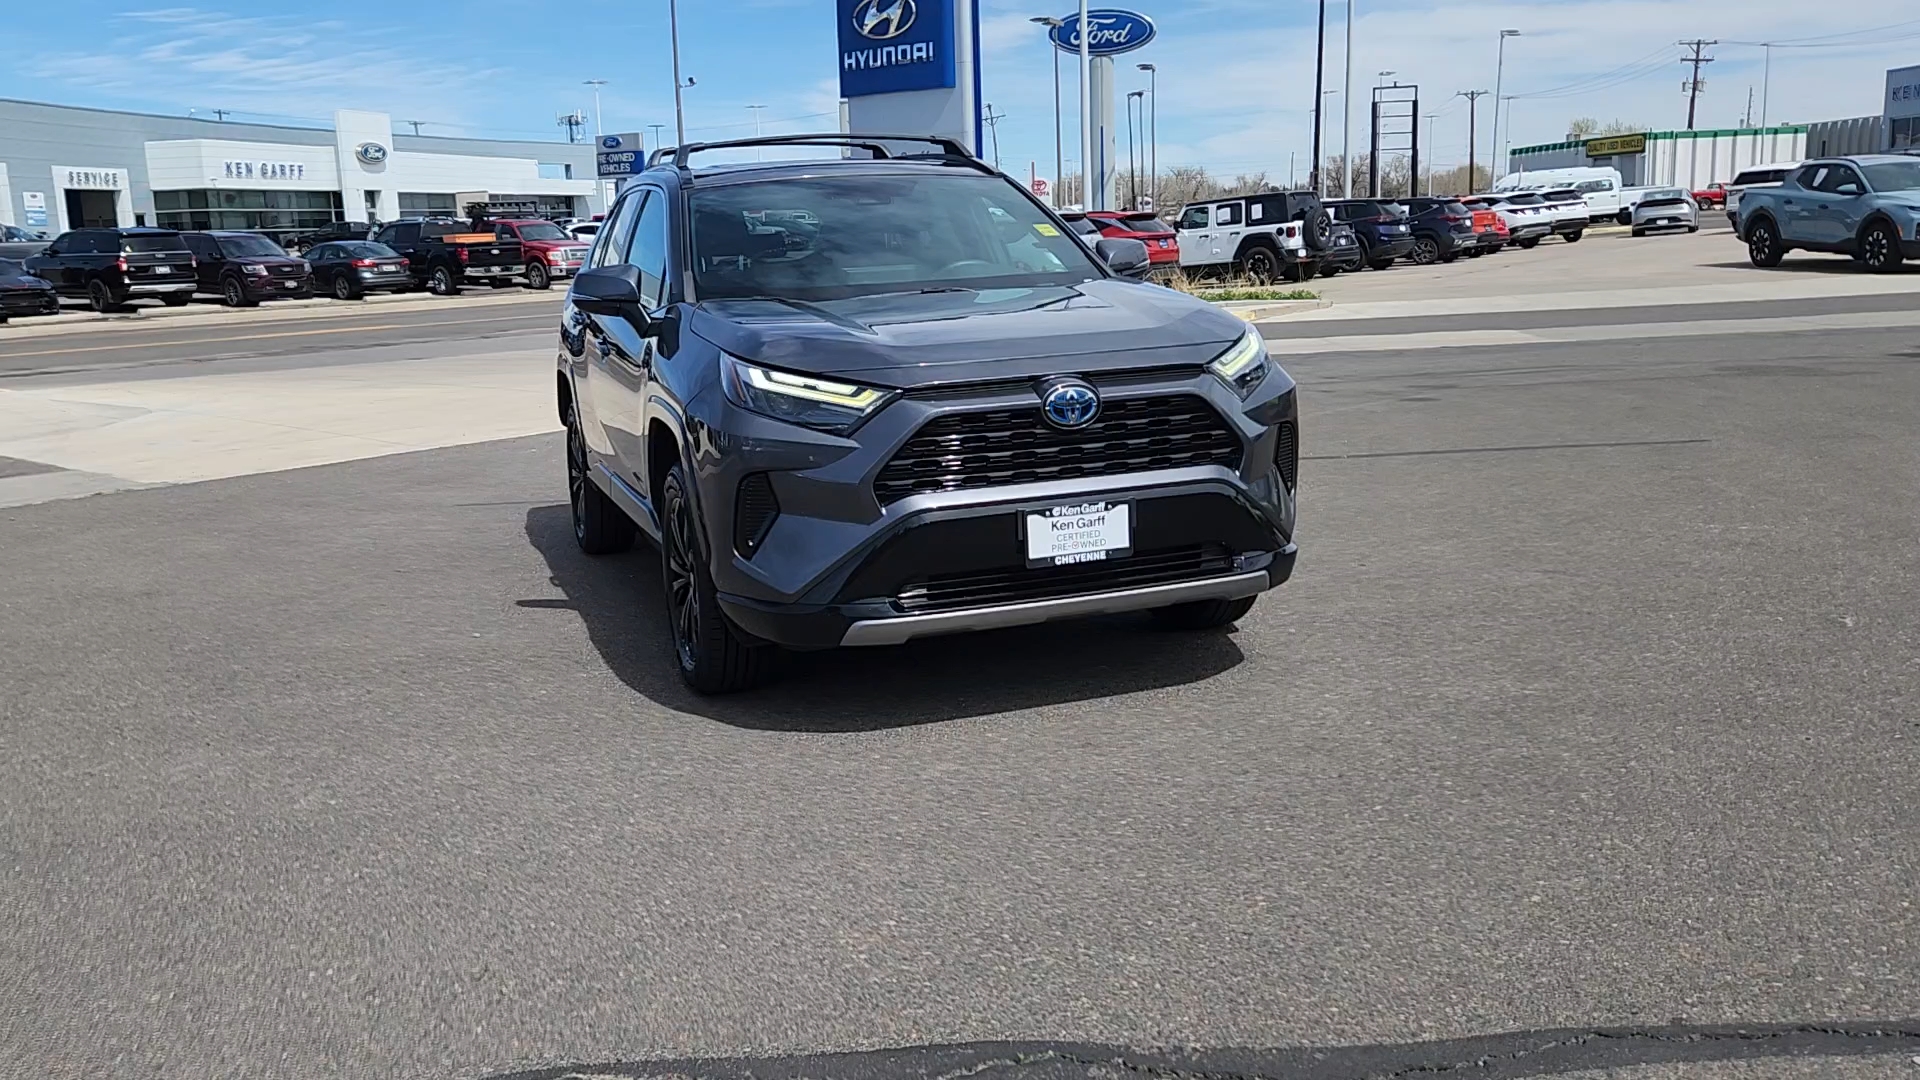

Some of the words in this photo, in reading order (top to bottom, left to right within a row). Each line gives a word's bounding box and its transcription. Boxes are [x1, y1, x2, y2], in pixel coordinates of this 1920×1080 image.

[1070, 17, 1132, 45] Ford
[843, 42, 935, 71] HYUNDAI
[366, 146, 384, 158] Ford
[224, 161, 254, 178] KEN
[260, 162, 304, 180] GARFF
[600, 163, 630, 173] VEHICLES
[67, 171, 119, 187] SERVICE
[1061, 505, 1080, 516] Ken
[1081, 501, 1105, 512] Garff
[1051, 520, 1074, 531] Ken
[1076, 515, 1106, 529] Garff
[1057, 530, 1100, 542] CERTIFIED
[1054, 551, 1106, 565] CHEYENNE
